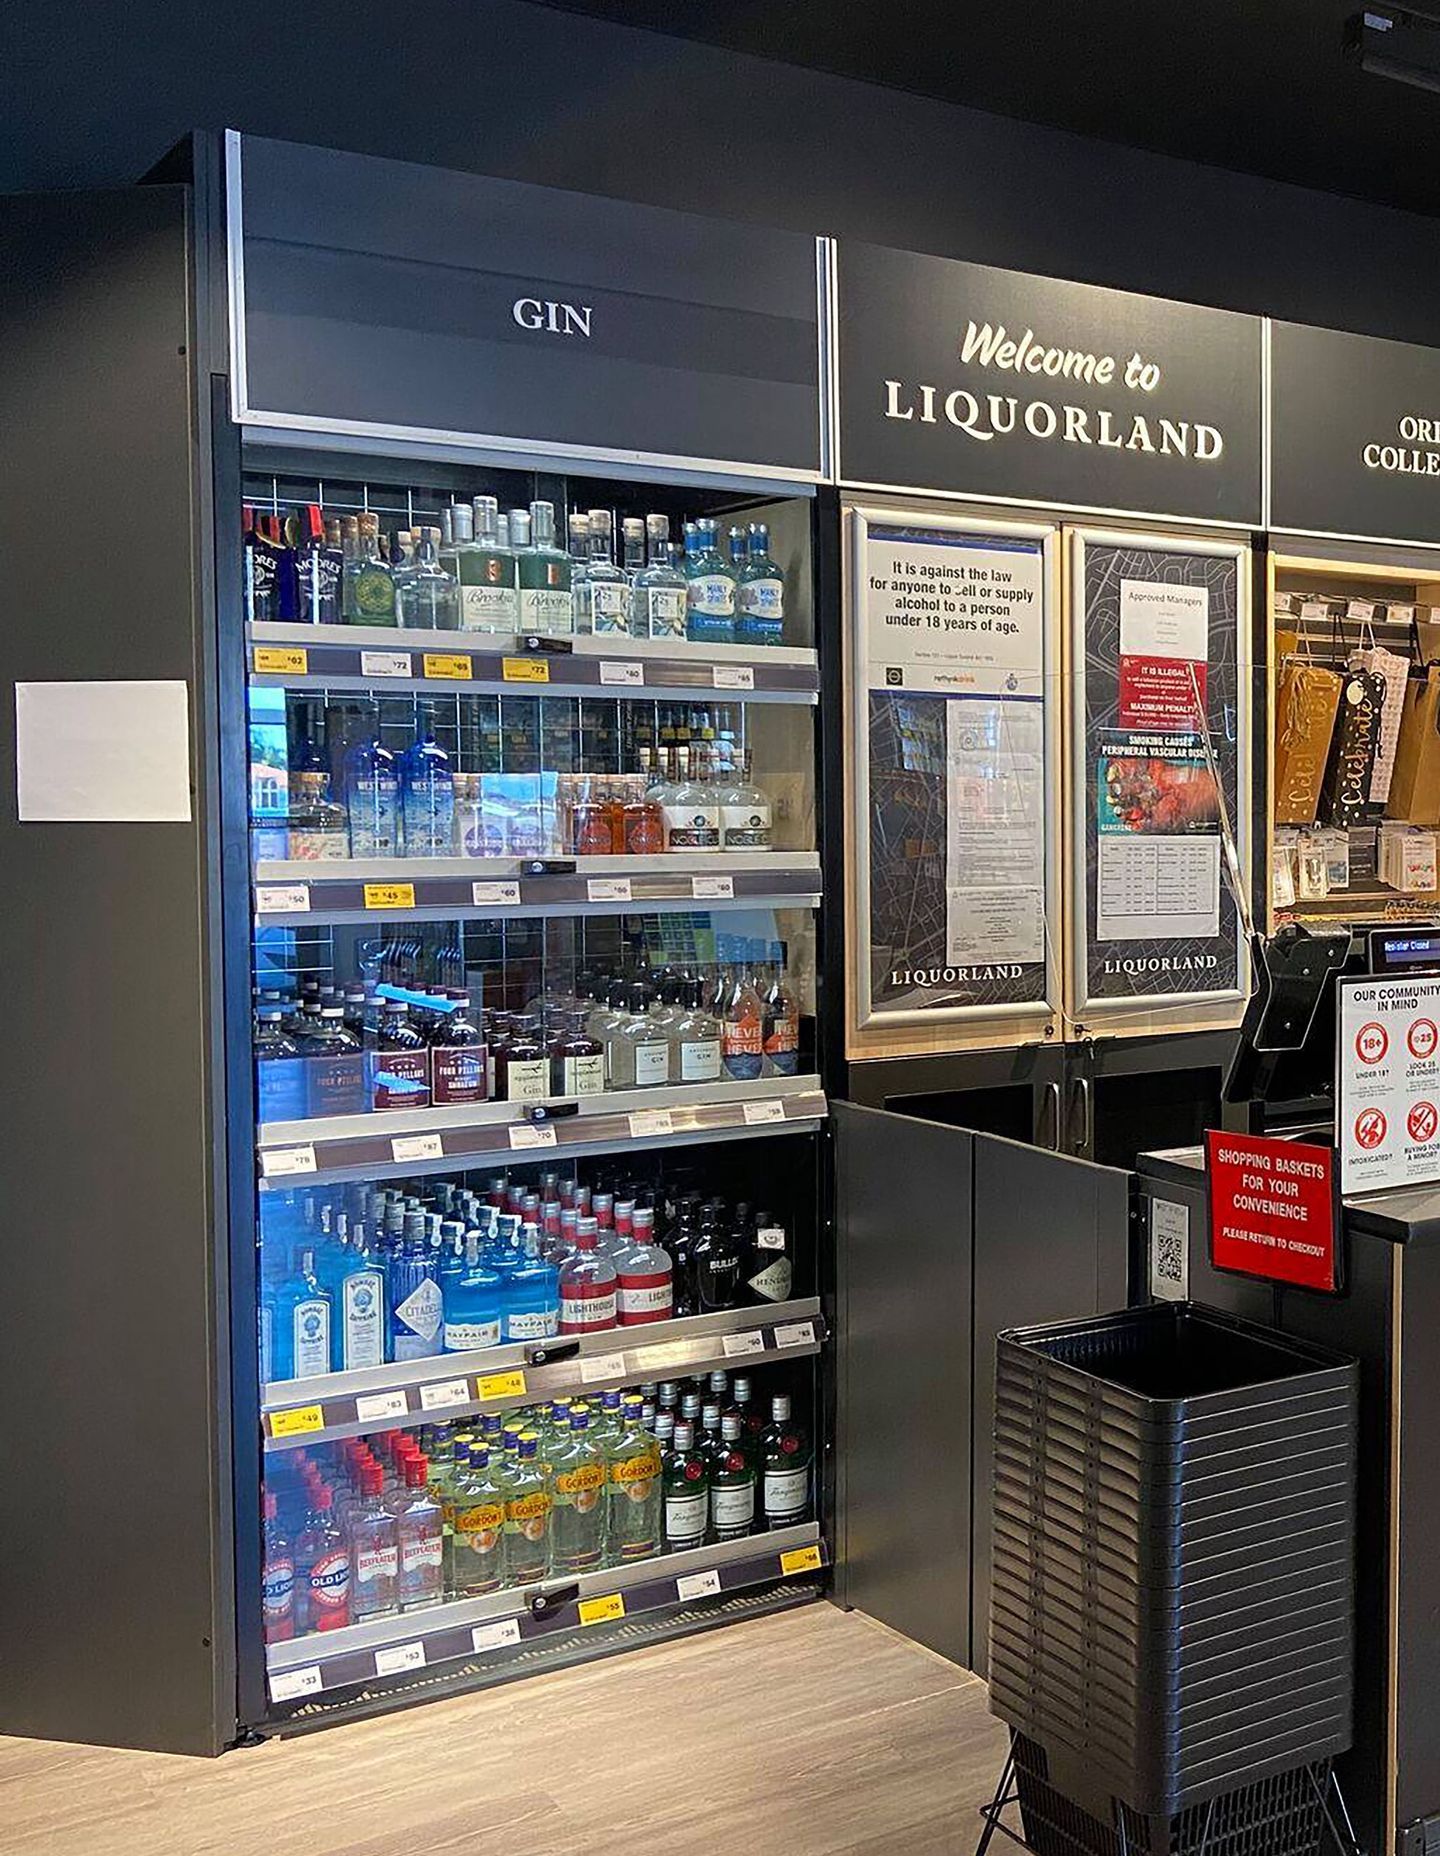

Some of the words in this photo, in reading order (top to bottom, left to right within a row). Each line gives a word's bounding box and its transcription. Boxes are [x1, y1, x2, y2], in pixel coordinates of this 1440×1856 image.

[513, 298, 593, 337] GIN
[961, 320, 1113, 384] Welcome
[1123, 354, 1160, 391] to
[885, 381, 1223, 459] LIQUORLAND
[893, 561, 902, 574] It
[906, 563, 916, 575] is
[920, 565, 964, 580] against
[969, 568, 987, 581] the
[991, 570, 1012, 582] law
[870, 577, 887, 589] for
[891, 582, 935, 596] anyone
[939, 583, 950, 595] to
[980, 588, 991, 598] or
[996, 588, 1033, 603] supply
[1129, 592, 1165, 602] Approved
[1167, 594, 1202, 607] Managers
[895, 597, 939, 610] alcohol
[944, 600, 955, 612] to
[960, 602, 966, 612] a
[971, 604, 1010, 616] person
[886, 615, 921, 627] under
[926, 616, 940, 627] 18
[945, 619, 977, 631] years
[981, 619, 992, 630] of
[996, 621, 1019, 635] age.
[1129, 735, 1163, 745] SMOKING
[1102, 746, 1148, 756] PERIPHERAL
[1149, 747, 1187, 758] VASCULAR
[1188, 748, 1218, 759] DISEE
[1341, 698, 1373, 804] Celebrate
[891, 965, 1023, 987] LIQUORLAND
[1105, 956, 1217, 976] LIQUORLAND
[1354, 989, 1376, 1001] OUR
[1379, 985, 1440, 999] COMMUNITY
[1377, 1001, 1388, 1012] IN
[1392, 998, 1418, 1010] MIND
[1218, 1149, 1270, 1169] SHOPPING
[1276, 1159, 1324, 1179] BASKETS
[1243, 1175, 1263, 1190] FOR
[1268, 1179, 1298, 1197] YOUR
[1233, 1195, 1308, 1221] CONVENIENCE
[1223, 1227, 1247, 1241] PLEASE
[1249, 1232, 1275, 1246] RETURN
[1278, 1238, 1286, 1248] TO
[1289, 1241, 1324, 1257] CHECKOUT
[312, 1576, 334, 1587] OLD
